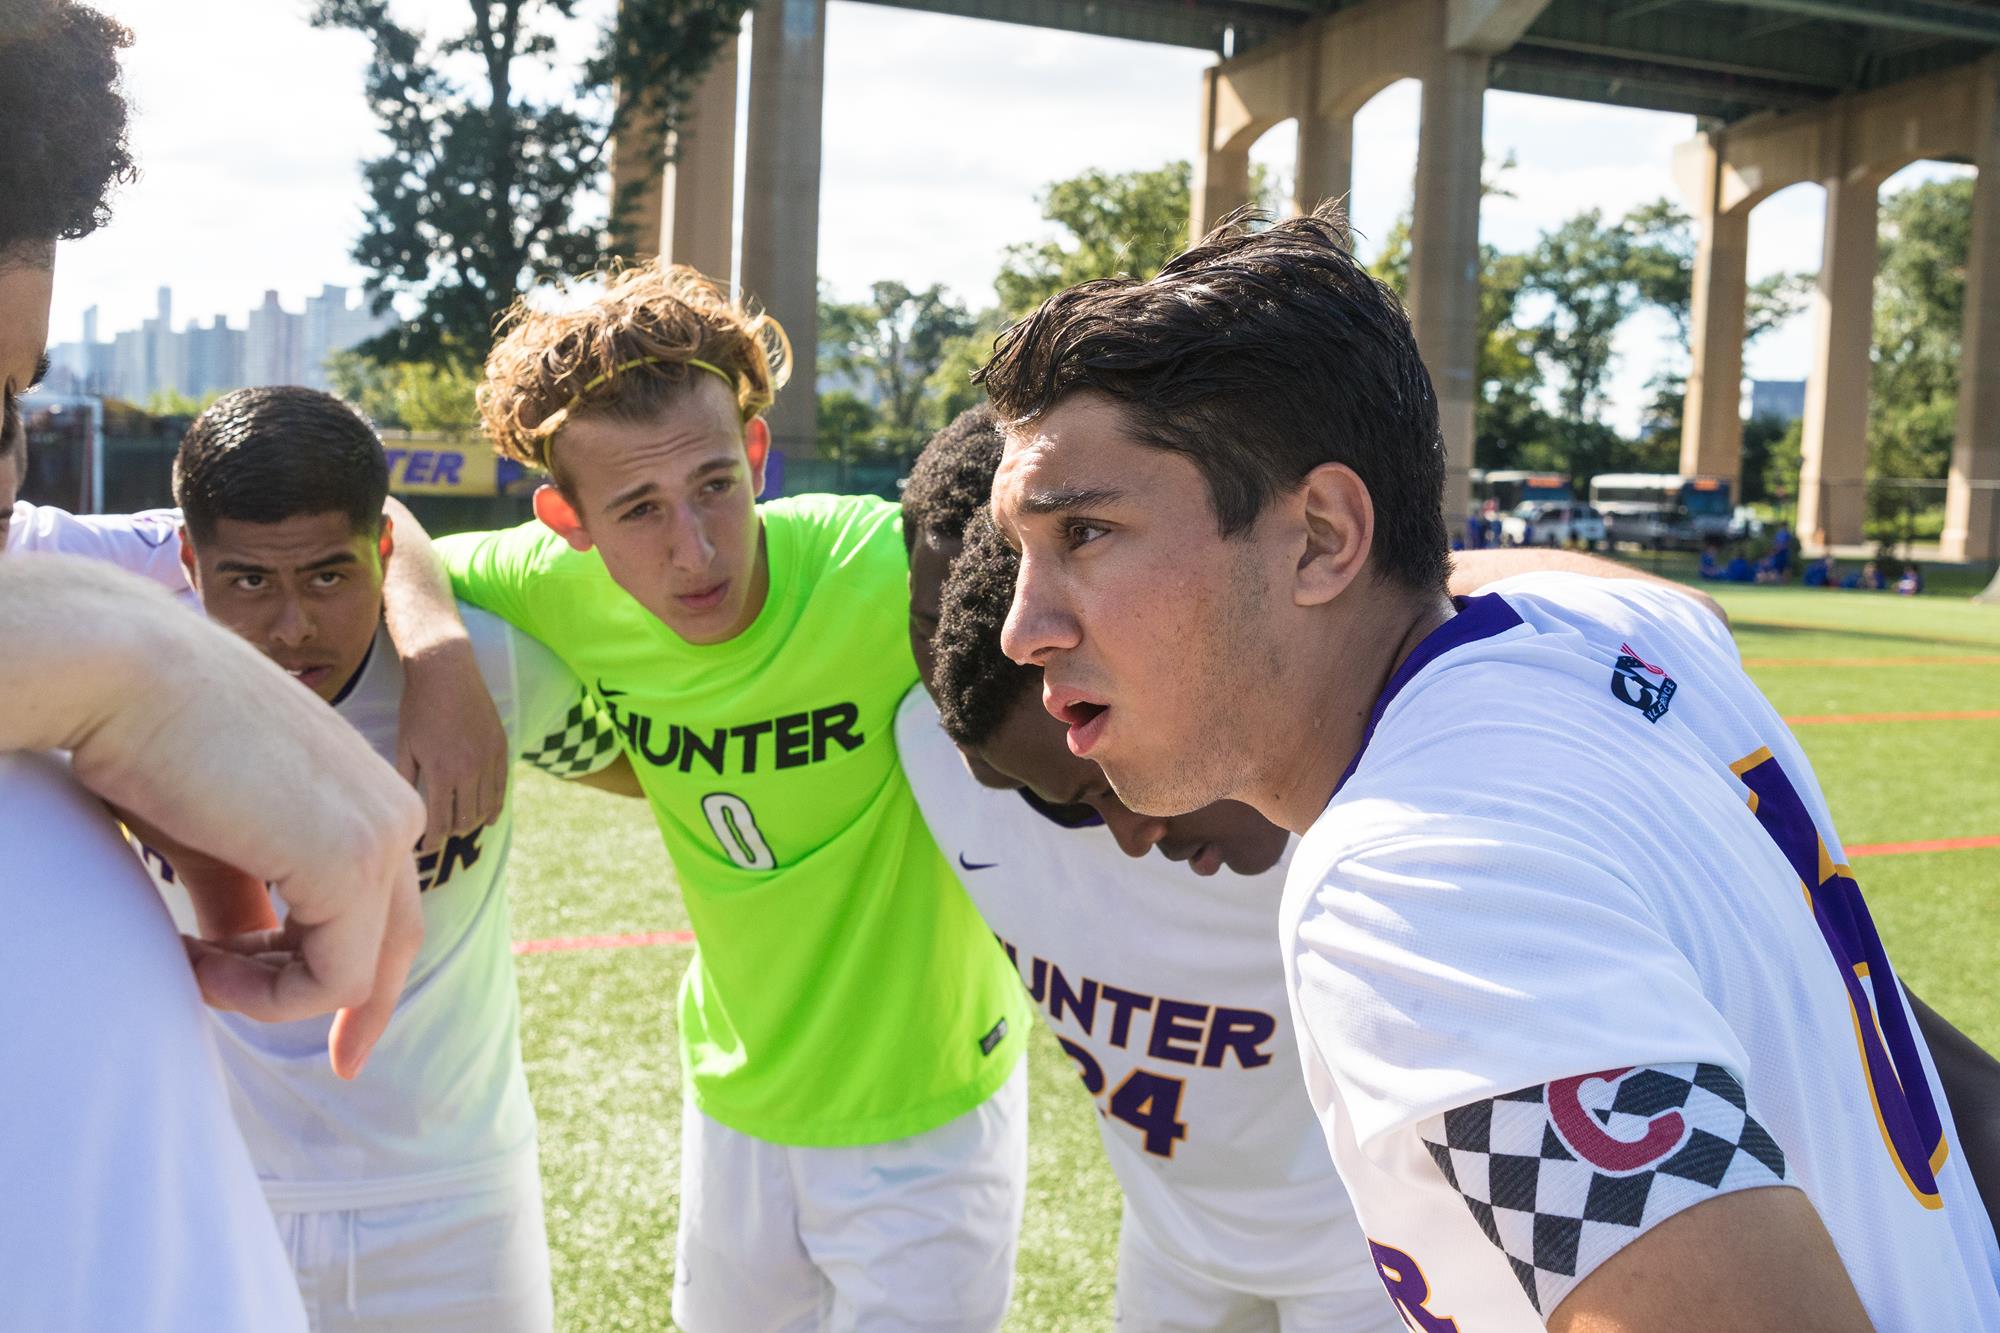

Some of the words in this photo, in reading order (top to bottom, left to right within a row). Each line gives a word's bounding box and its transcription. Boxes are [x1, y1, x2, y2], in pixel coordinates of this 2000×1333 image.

[604, 700, 865, 776] HUNTER
[701, 791, 778, 872] 0
[994, 932, 1277, 1070] UNTER
[1546, 1065, 1687, 1173] C
